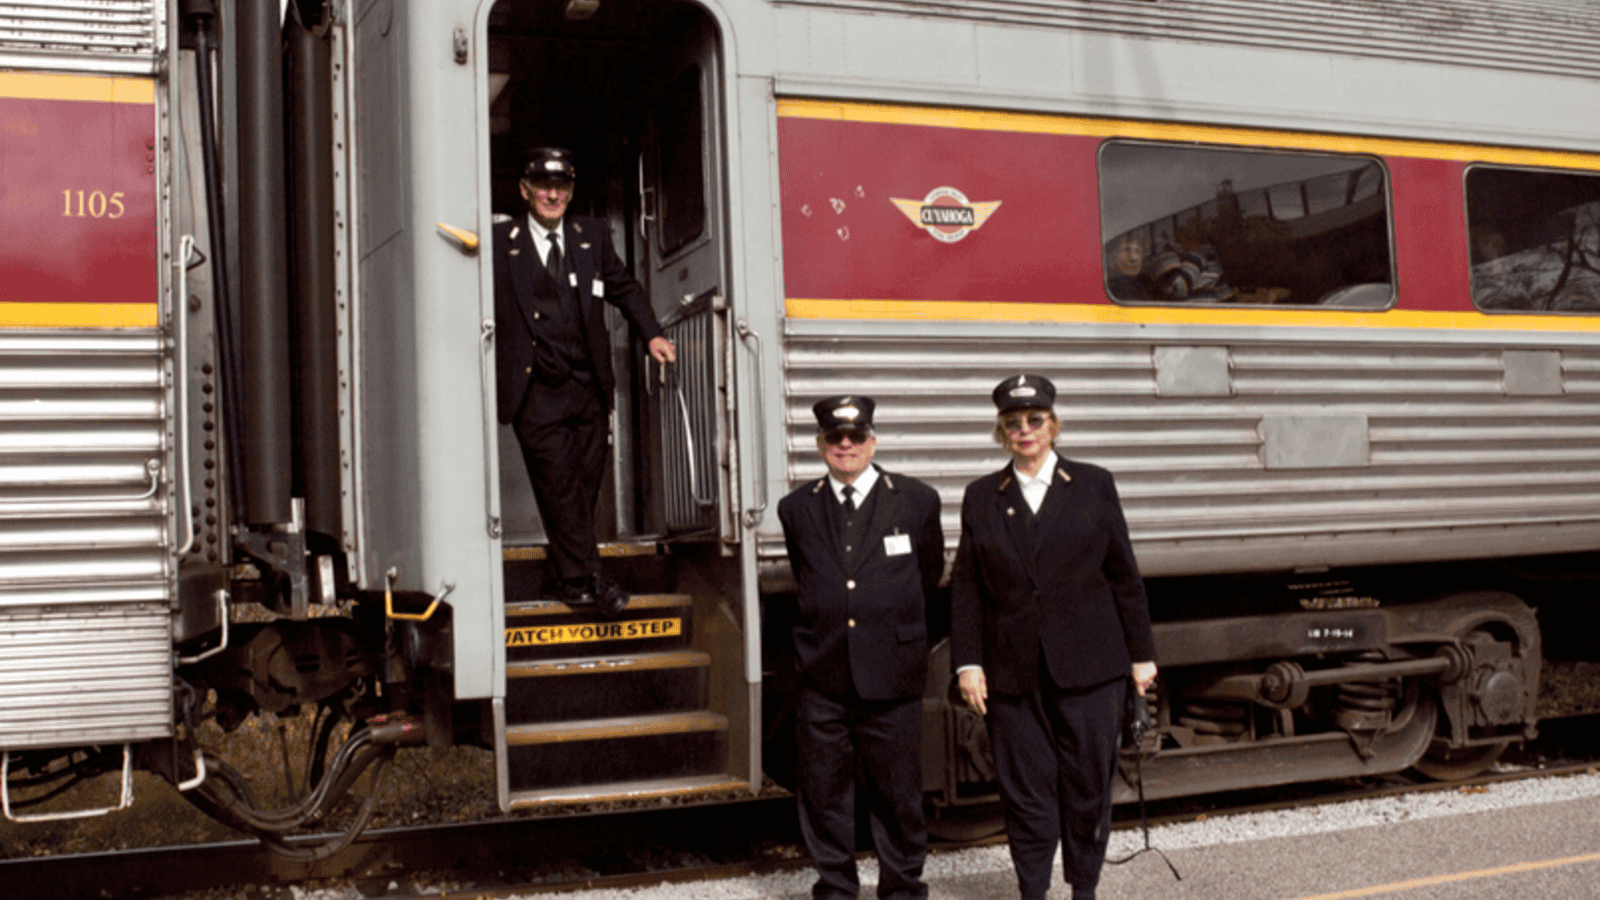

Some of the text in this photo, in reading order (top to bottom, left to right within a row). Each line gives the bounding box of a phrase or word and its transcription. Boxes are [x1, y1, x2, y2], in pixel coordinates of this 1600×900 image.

[62, 188, 125, 218] 1105
[921, 209, 973, 223] CUYAHOGA
[568, 624, 623, 639] YOUR
[627, 620, 673, 636] STEP
